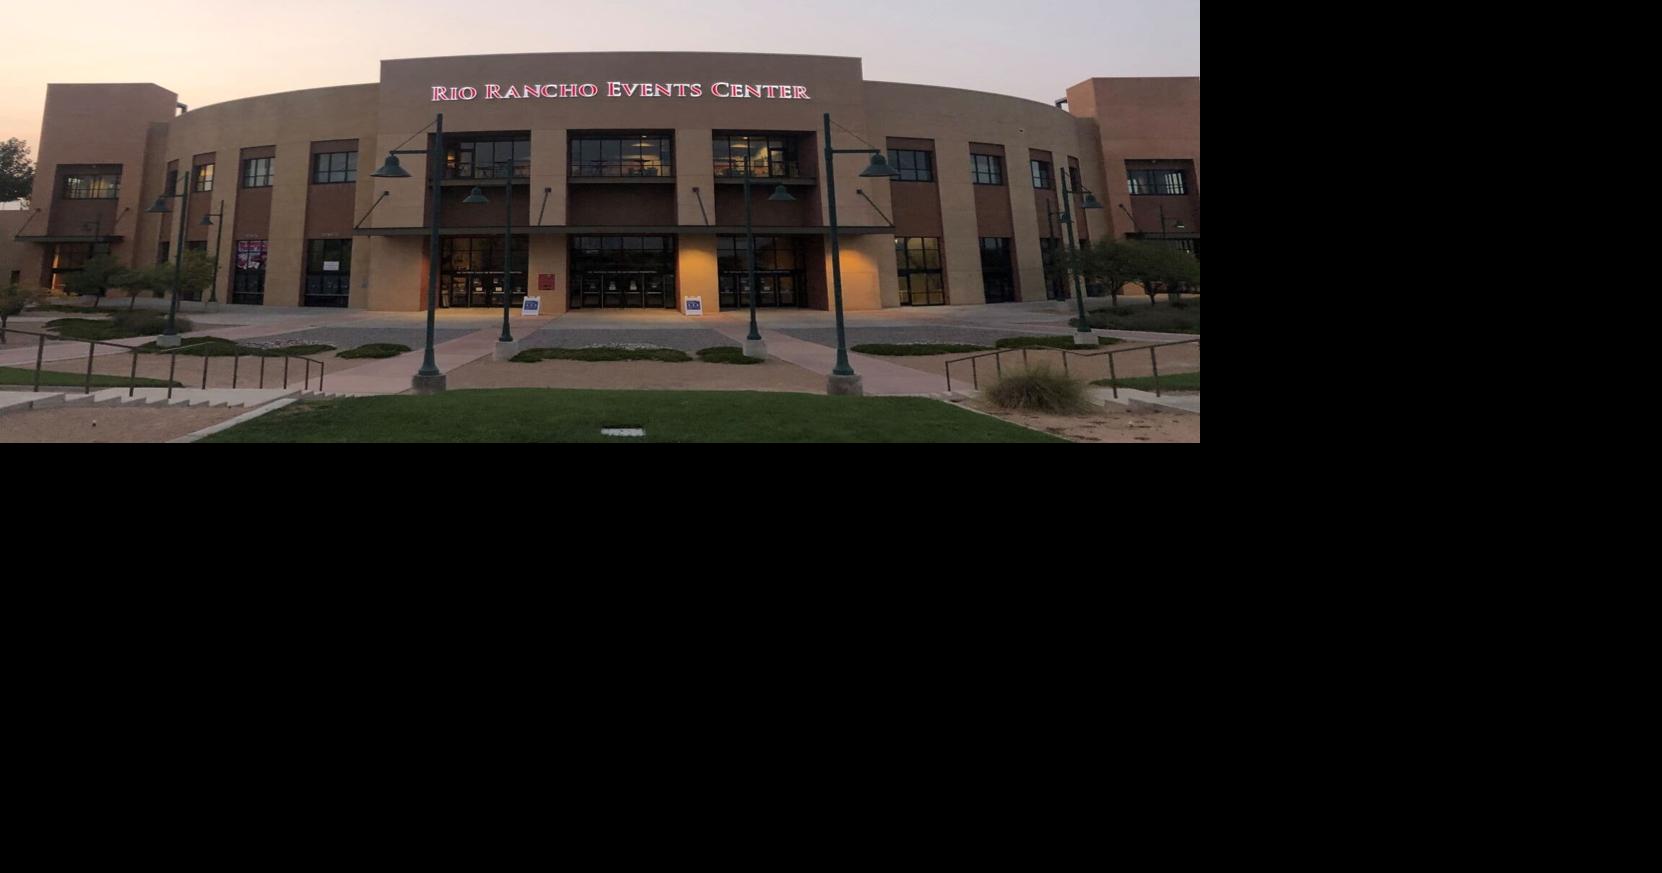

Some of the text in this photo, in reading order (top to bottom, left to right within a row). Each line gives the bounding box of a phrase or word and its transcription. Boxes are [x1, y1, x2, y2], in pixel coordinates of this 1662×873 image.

[431, 81, 811, 101] RIO RANCHO EVENTS CENTER
